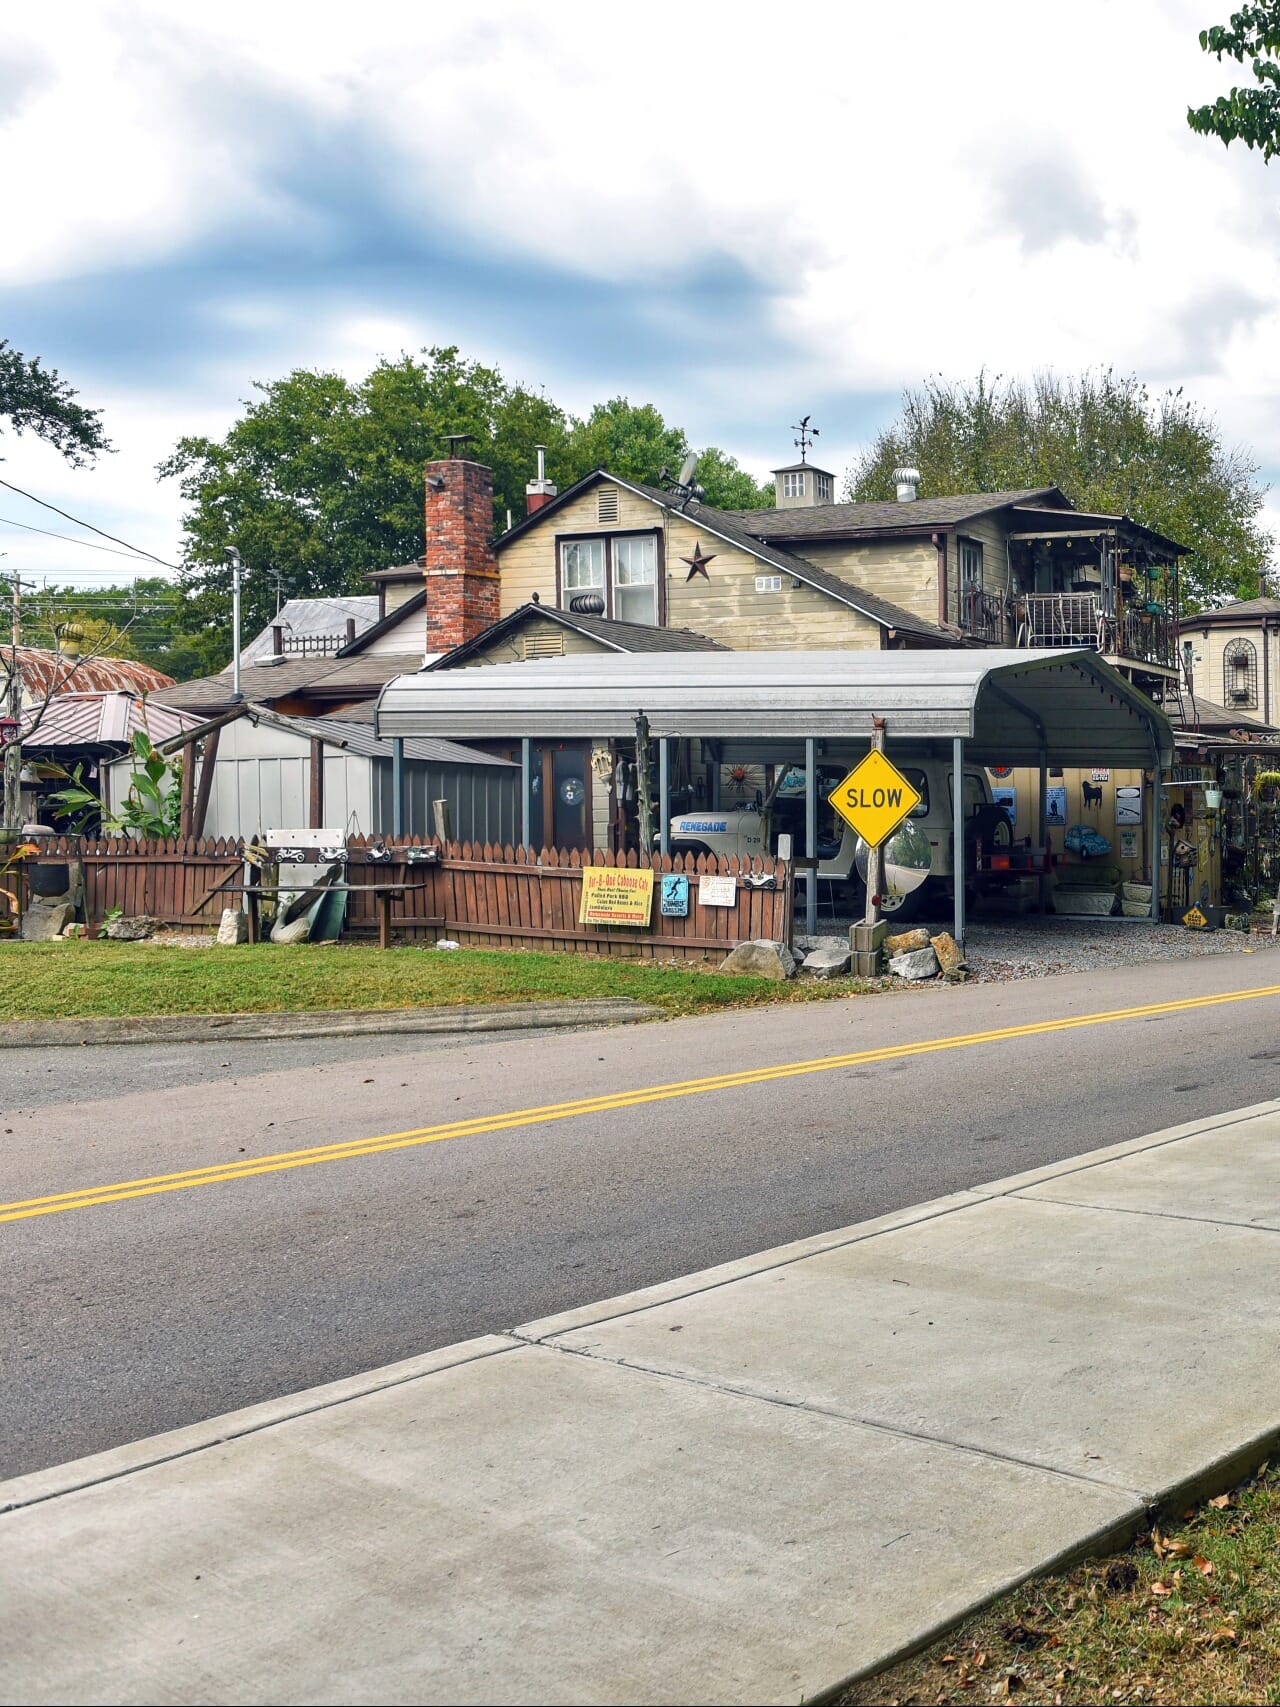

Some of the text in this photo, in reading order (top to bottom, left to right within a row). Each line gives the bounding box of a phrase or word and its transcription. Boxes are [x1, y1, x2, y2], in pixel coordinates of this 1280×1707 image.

[846, 788, 903, 808] SLOW
[680, 822, 728, 832] RENEGADE
[617, 874, 638, 888] Caboose
[638, 877, 649, 891] Cafe
